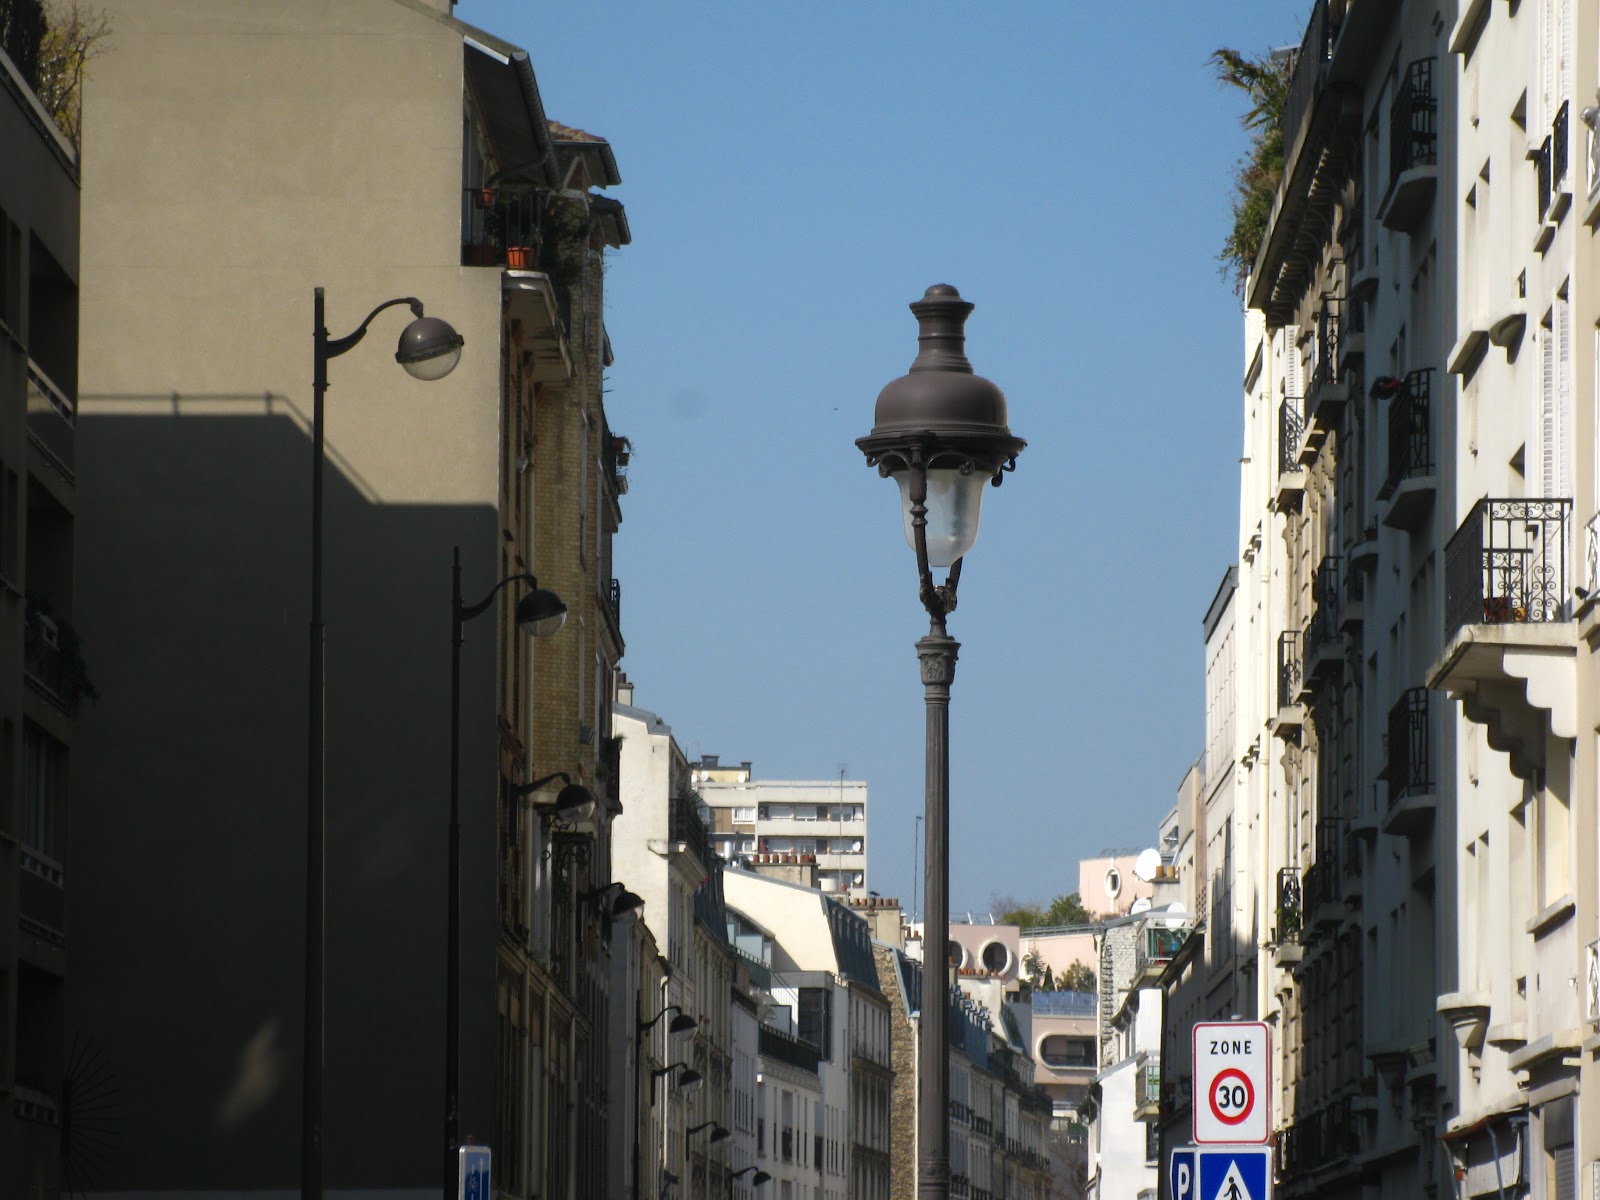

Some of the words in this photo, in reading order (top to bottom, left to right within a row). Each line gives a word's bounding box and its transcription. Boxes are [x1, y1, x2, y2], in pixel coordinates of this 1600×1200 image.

[1210, 1040, 1252, 1055] ZONE
[1218, 1085, 1246, 1109] 30
[1178, 1163, 1190, 1200] P
